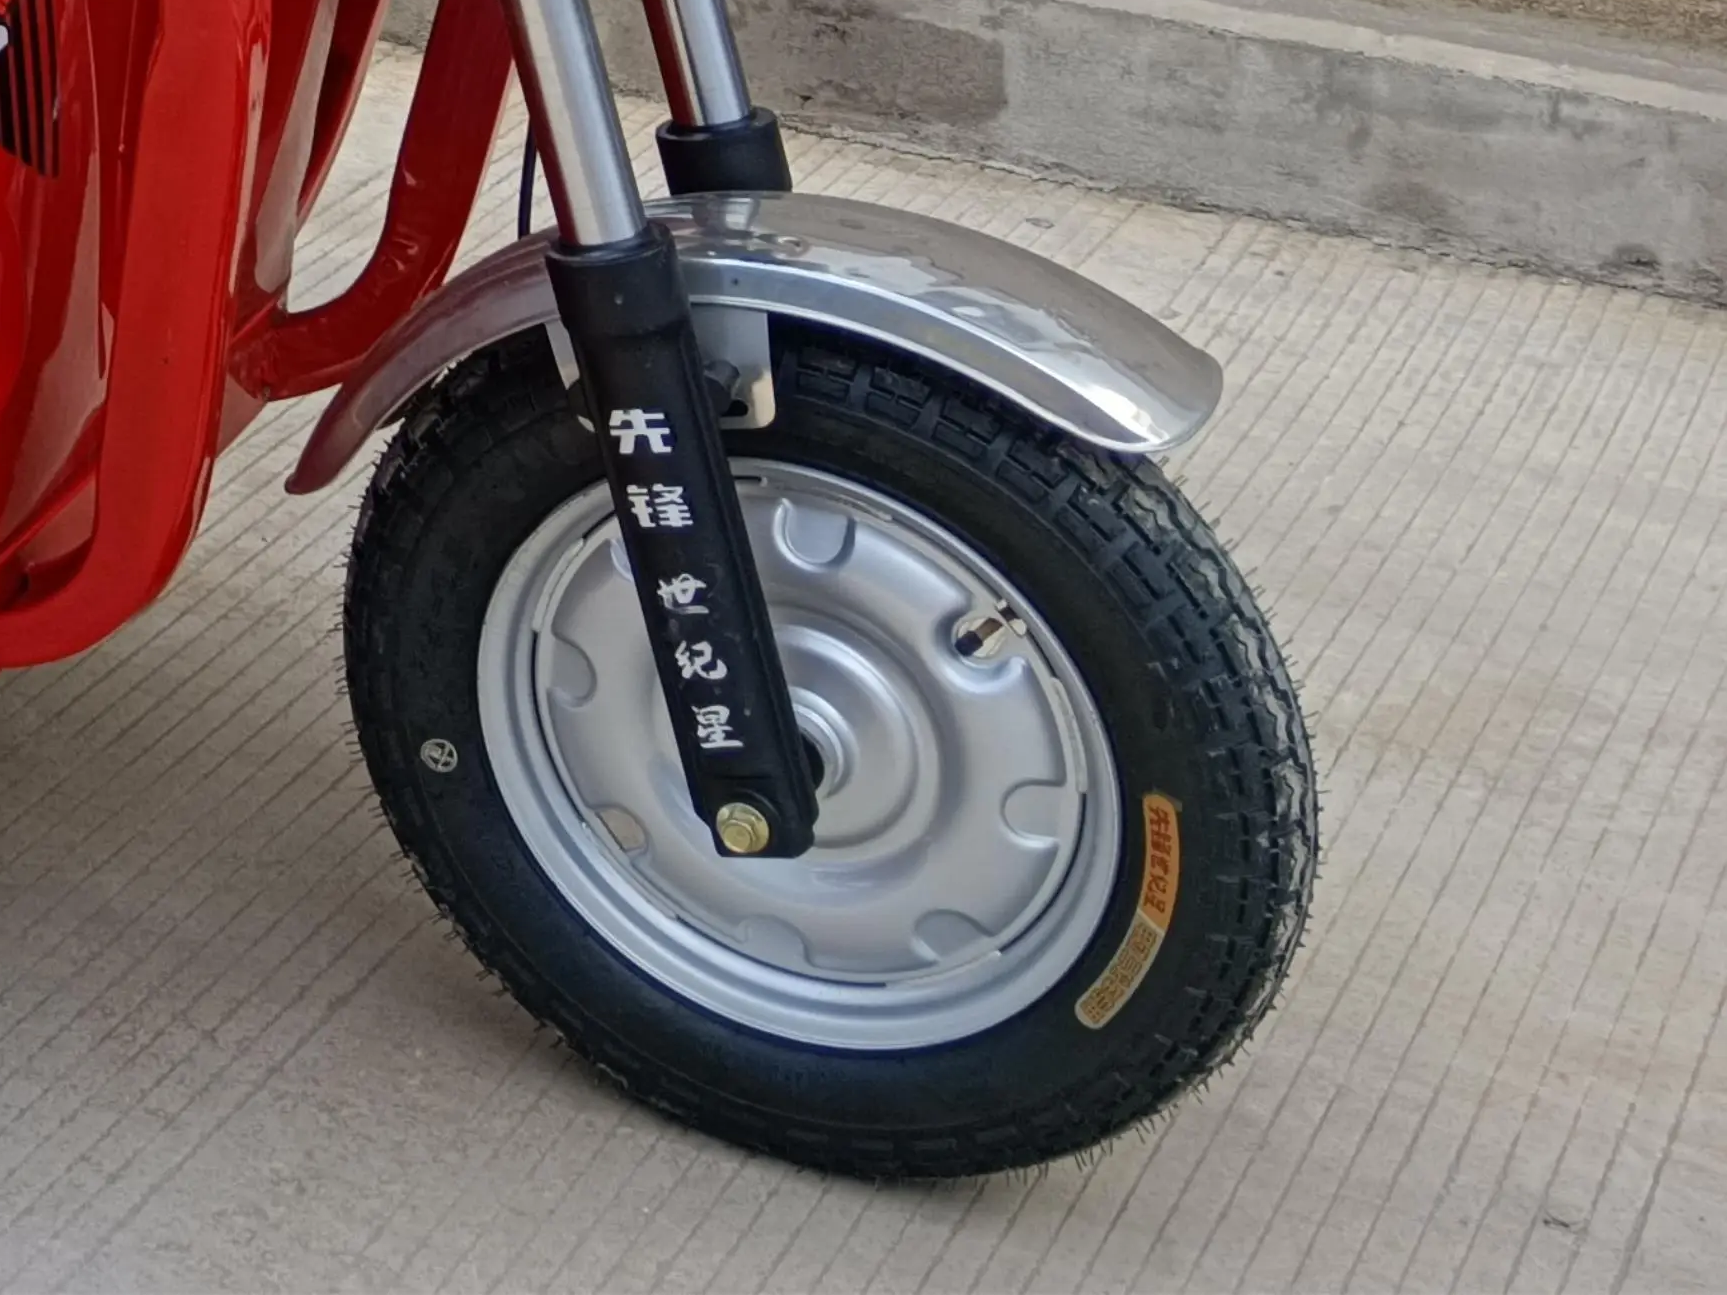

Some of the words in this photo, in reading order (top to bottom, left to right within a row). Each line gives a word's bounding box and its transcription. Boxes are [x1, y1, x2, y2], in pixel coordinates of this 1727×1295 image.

[608, 407, 745, 751] 先锋世纪星
